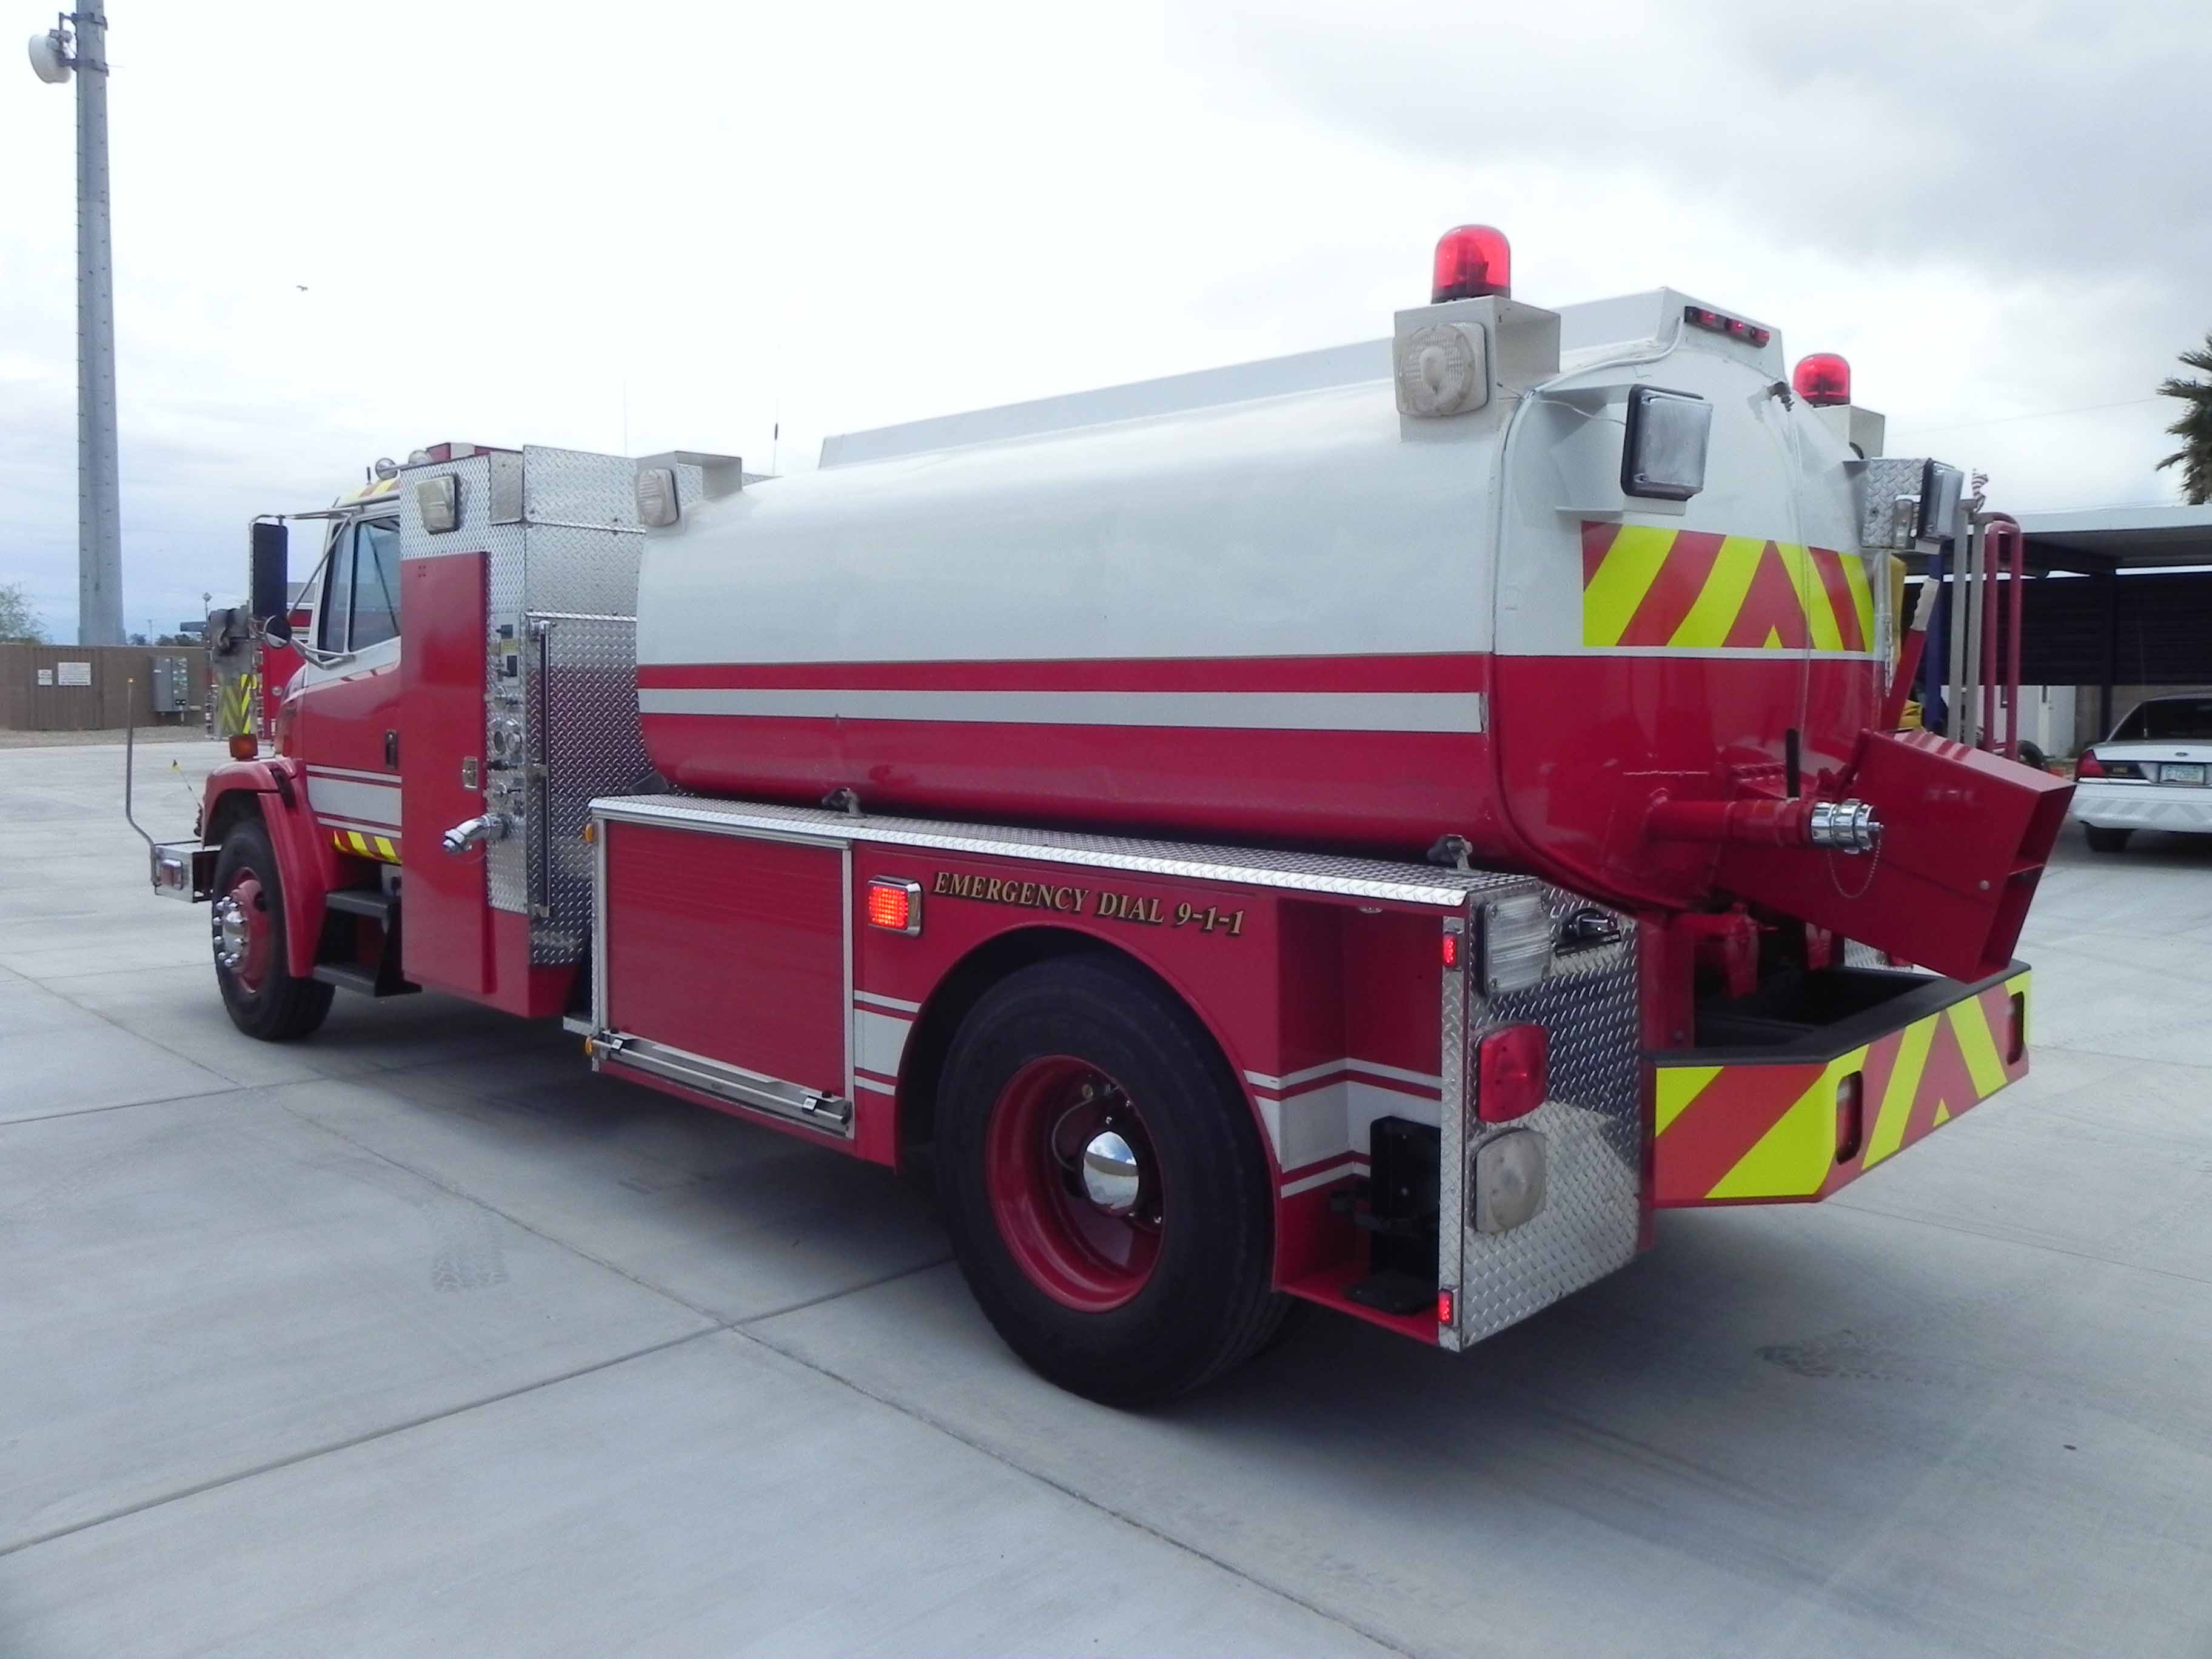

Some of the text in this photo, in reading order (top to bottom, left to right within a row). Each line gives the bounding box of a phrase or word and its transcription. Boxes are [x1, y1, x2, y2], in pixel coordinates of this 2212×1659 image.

[934, 871, 1244, 934] EMERGENCY DIAL 9-1-1
